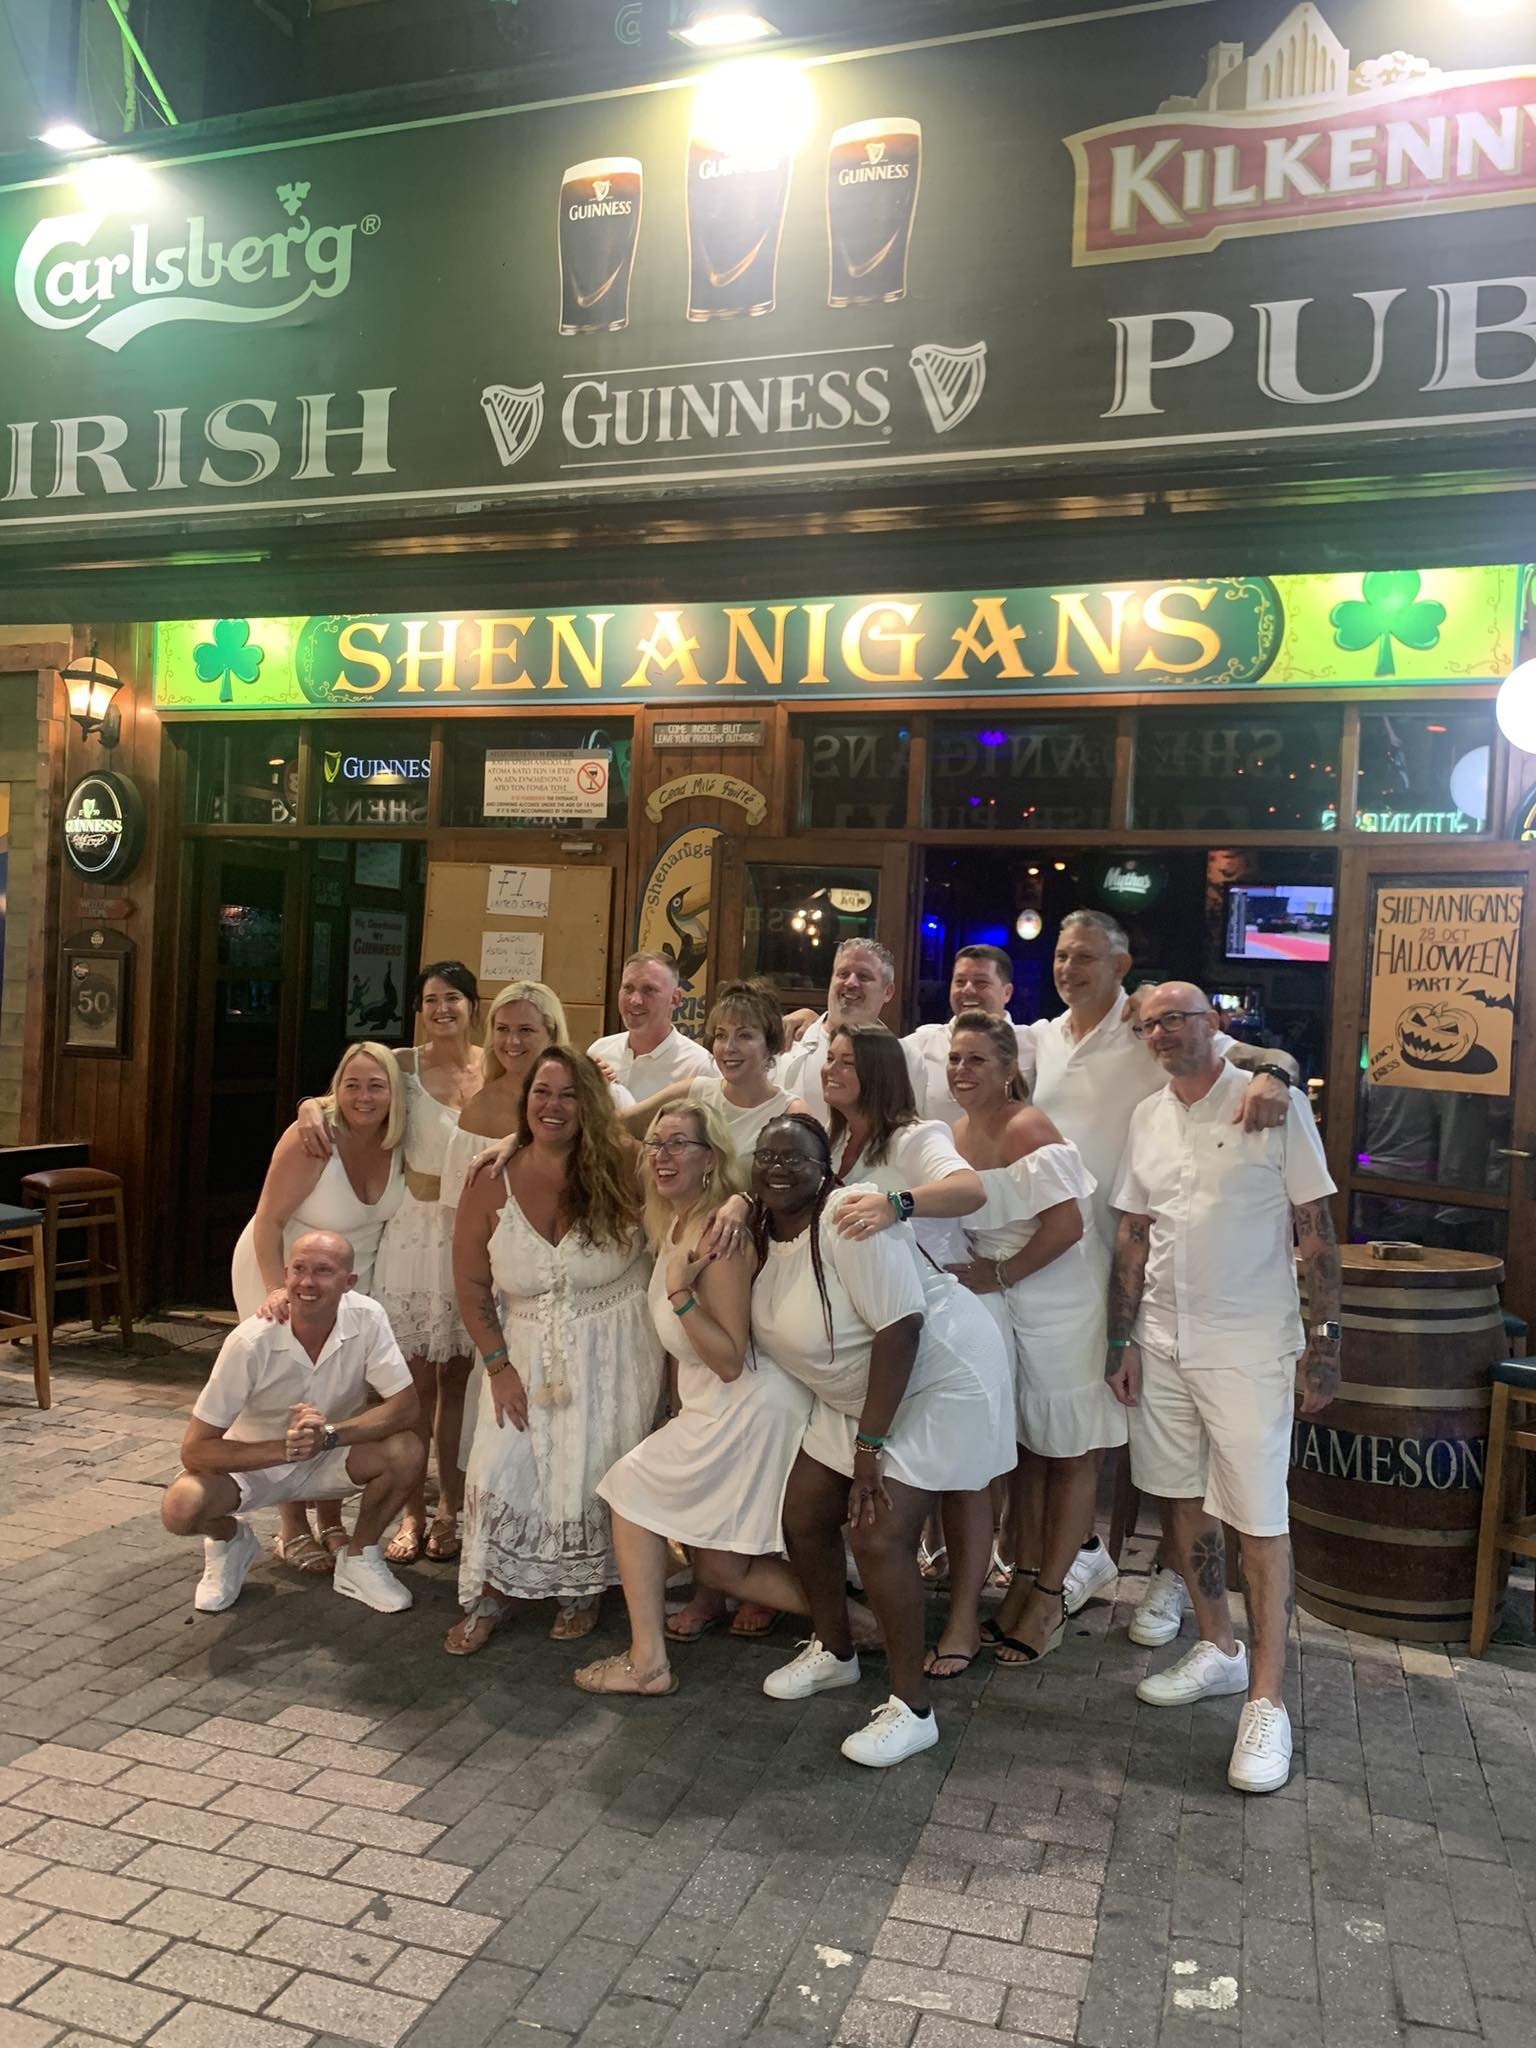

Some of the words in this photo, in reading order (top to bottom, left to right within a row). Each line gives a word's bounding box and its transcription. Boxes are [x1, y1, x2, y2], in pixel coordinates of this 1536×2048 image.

[838, 163, 910, 186] GUINNESS
[1109, 104, 1536, 233] KILKENN
[568, 199, 633, 222] GUINNESS
[14, 207, 358, 352] Carlsberg
[1101, 276, 1536, 418] PUB
[561, 366, 890, 450] GUINNESS
[3, 387, 398, 500] IRISH
[337, 585, 1221, 695] SHENANIGANS
[692, 724, 717, 733] INSIDE
[722, 723, 742, 733] BUT
[343, 756, 431, 779] GUINNES
[65, 818, 123, 834] GUINNESS
[497, 870, 527, 896] F1
[648, 842, 714, 906] Shenaniga
[1380, 894, 1522, 925] SHENANIGANS
[1419, 928, 1436, 943] 28
[1442, 928, 1470, 943] OCT
[1375, 928, 1518, 983] HALLOWEEN
[1408, 977, 1469, 992] PARTY
[77, 990, 111, 1015] 50
[1292, 1422, 1484, 1491] JAMESON
